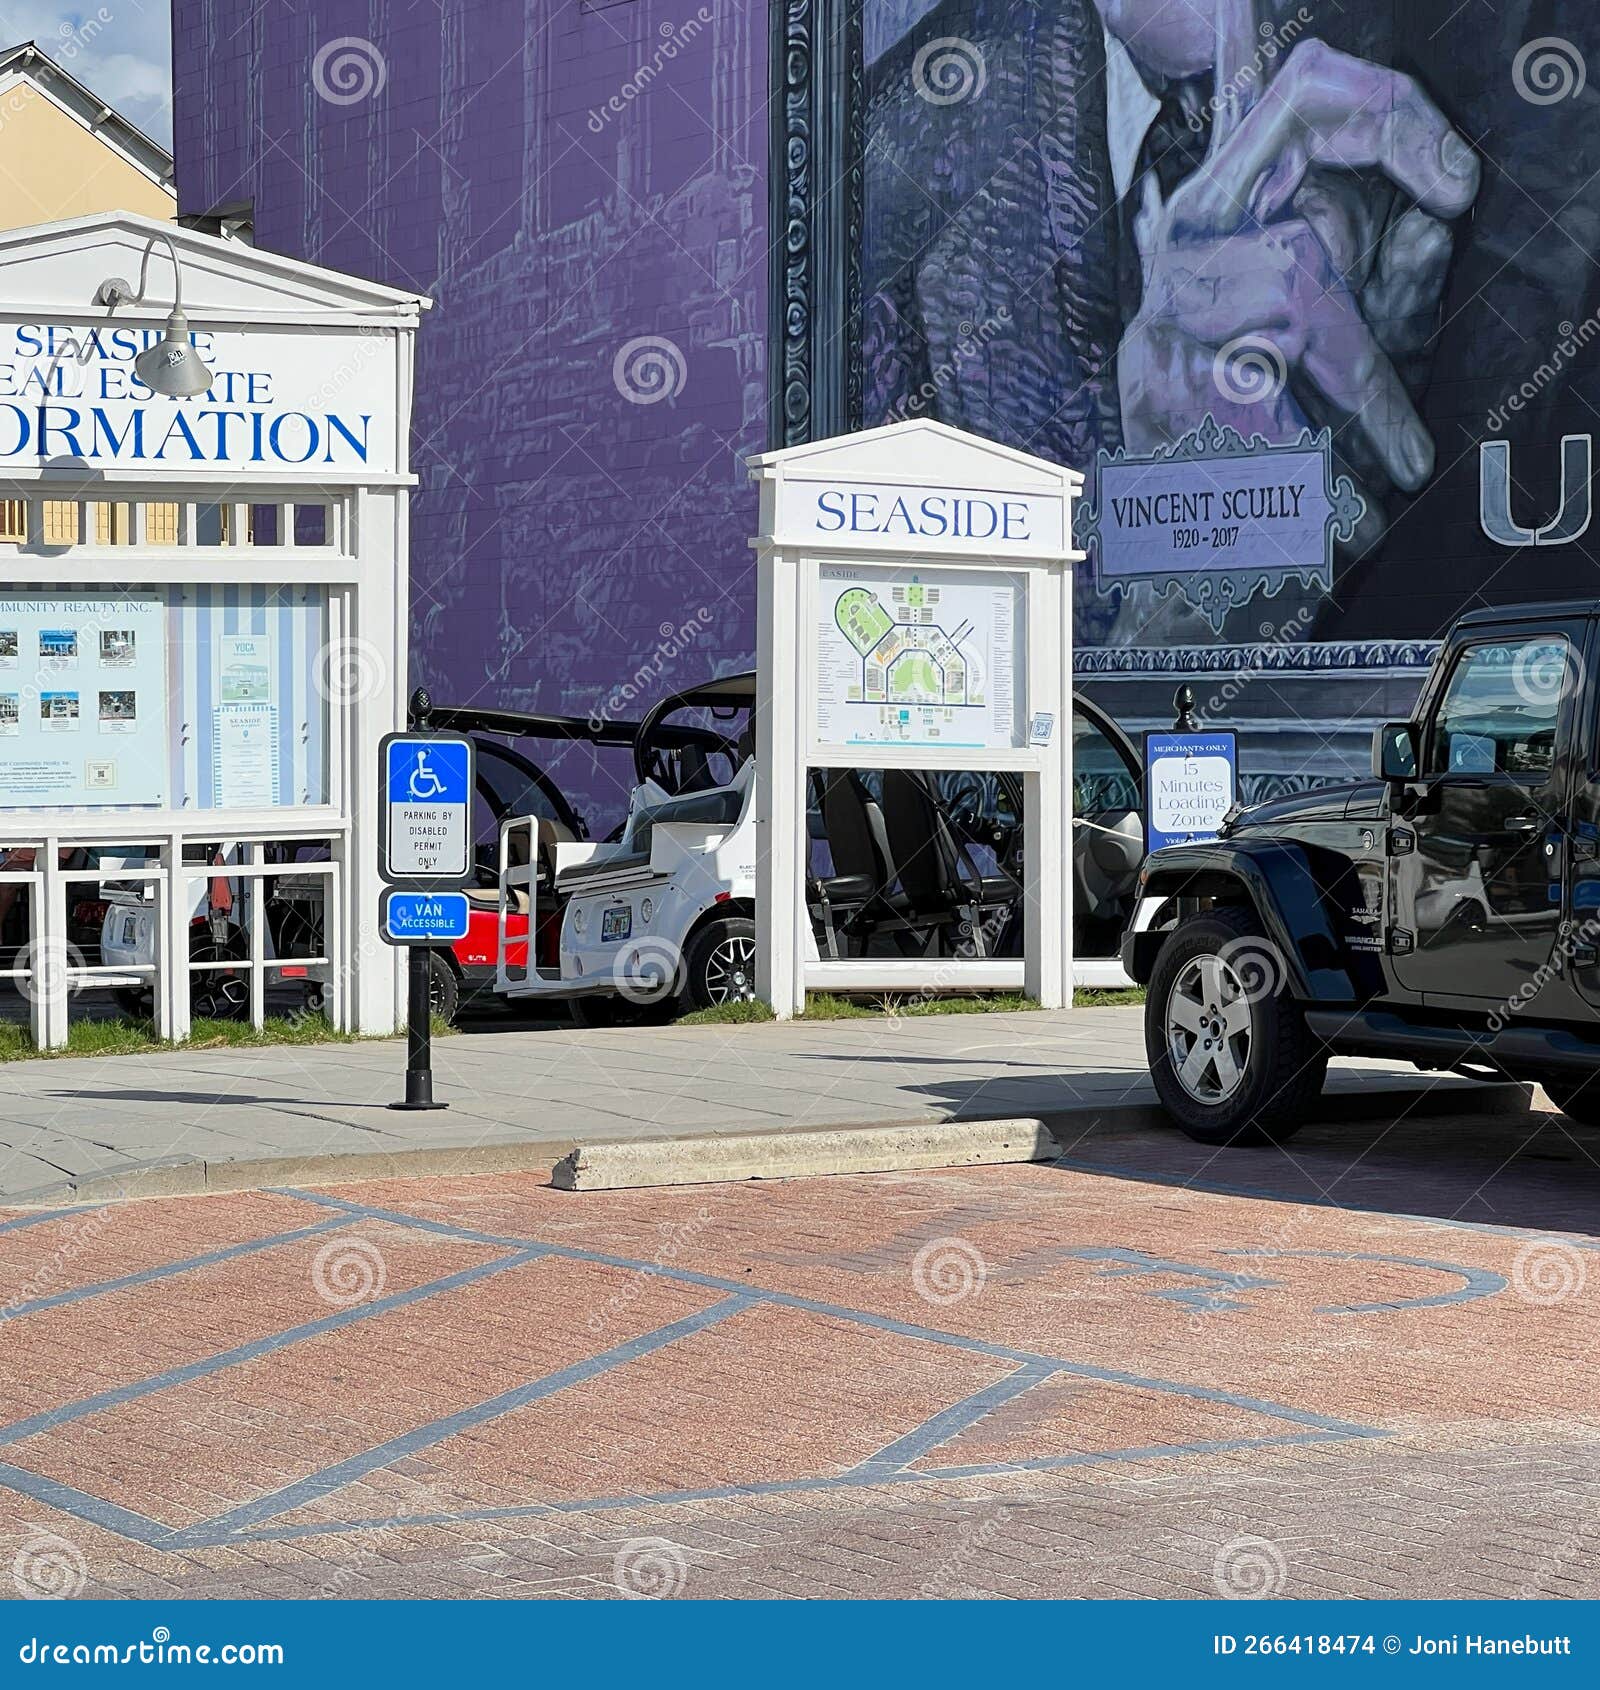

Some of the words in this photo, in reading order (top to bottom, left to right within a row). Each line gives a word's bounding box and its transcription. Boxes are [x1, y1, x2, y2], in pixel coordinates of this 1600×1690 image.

[15, 325, 217, 363] SEASIE
[99, 367, 274, 403] ESTE
[0, 403, 372, 464] ORMATION
[1480, 433, 1592, 546] U
[1112, 492, 1215, 528] VINCENT
[1222, 484, 1306, 520] SCULLY
[816, 491, 1031, 540] SEASIDE
[63, 602, 120, 613] REALTY,
[126, 602, 152, 612] INC.
[1184, 763, 1199, 775] 15
[1160, 779, 1224, 793] Minutes
[1158, 795, 1226, 811] Loading
[404, 811, 437, 820] PARKING
[443, 811, 453, 820] BY
[1171, 813, 1213, 826] Zone
[409, 826, 448, 836] DISABLED
[414, 842, 442, 851] PERMIT
[418, 857, 438, 866] ONLY
[415, 903, 443, 916] VAN
[401, 918, 456, 928] ACCESSIBLE
